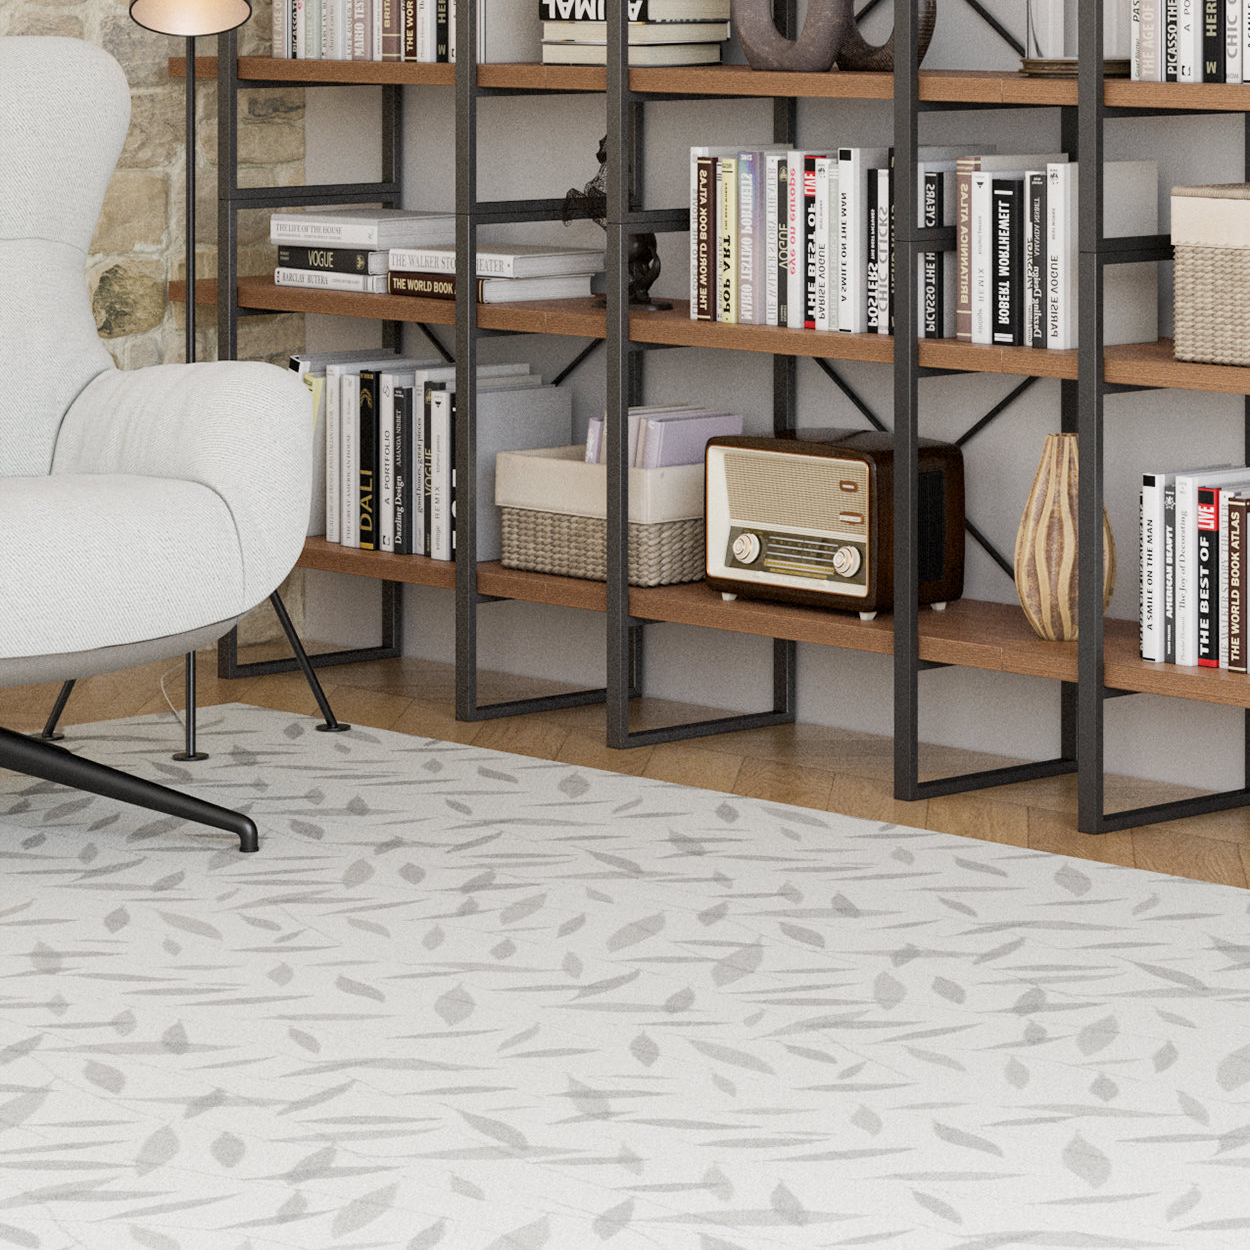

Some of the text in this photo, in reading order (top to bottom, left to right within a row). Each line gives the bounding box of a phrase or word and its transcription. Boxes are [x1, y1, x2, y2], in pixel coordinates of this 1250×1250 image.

[1168, 0, 1178, 23] THE
[406, 29, 414, 51] THE
[1168, 25, 1178, 74] PICASSO
[1227, 15, 1238, 59] CHIC
[308, 250, 334, 268] VOGUE
[392, 278, 453, 294] THE WORLD BOOK
[360, 469, 373, 532] DALI
[1147, 570, 1154, 586] ON
[1166, 525, 1174, 619] AMERICAN BEAUTY
[1231, 512, 1240, 661] THE WORLD BOOK ATLAS
[1200, 536, 1210, 656] THE BEST OF
